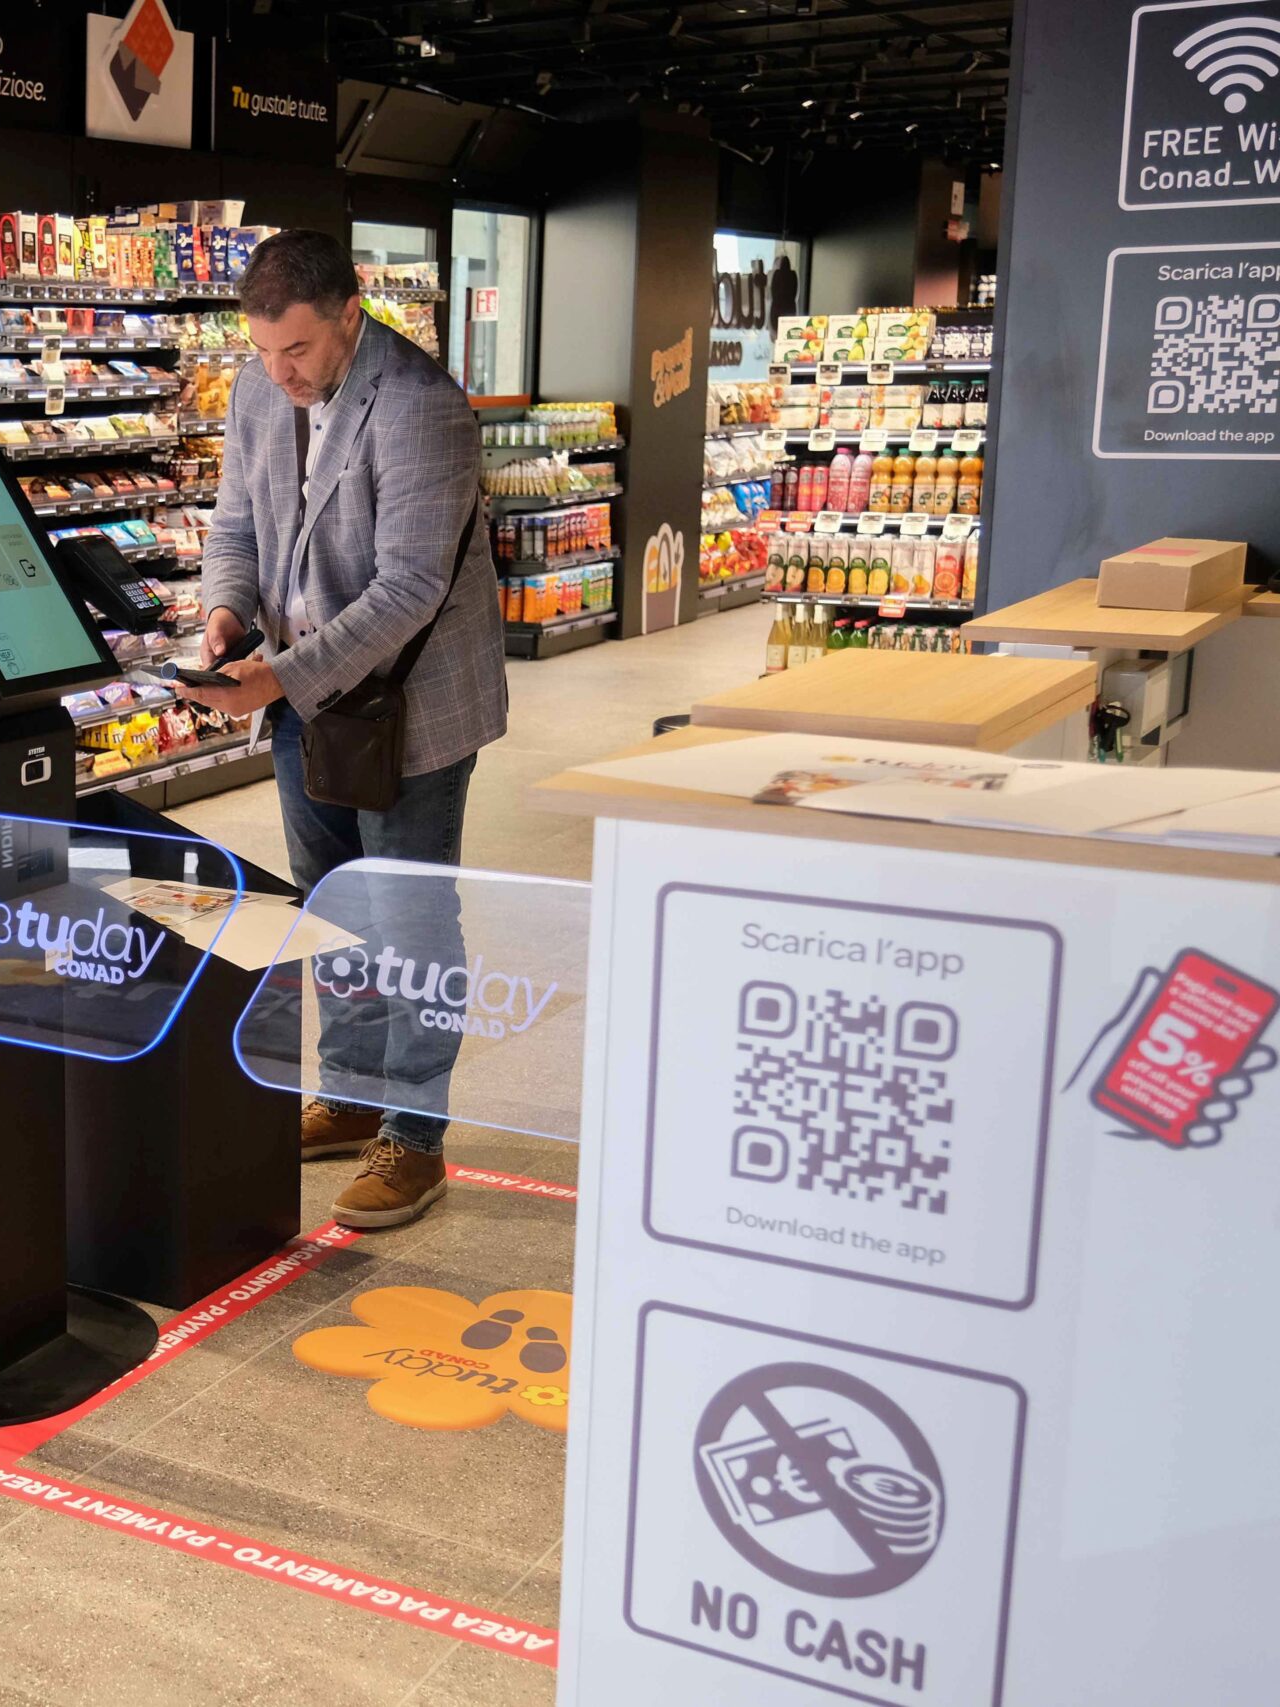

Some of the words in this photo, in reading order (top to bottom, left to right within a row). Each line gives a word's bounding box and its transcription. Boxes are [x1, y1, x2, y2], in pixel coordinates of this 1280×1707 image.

[232, 85, 249, 109] Tu
[251, 91, 295, 119] gustale
[297, 101, 328, 123] tutte.
[1143, 126, 1223, 158] FREE
[1238, 122, 1280, 153] Wi
[1139, 160, 1280, 191] Conad_W
[1157, 264, 1233, 282] Scarica
[1238, 261, 1280, 284] l'ap
[1144, 429, 1216, 442] Download
[1219, 430, 1245, 442] the
[1249, 432, 1274, 445] app
[16, 901, 166, 978] tuday
[741, 922, 867, 964] Scarica
[875, 938, 965, 981] l'app
[53, 955, 125, 984] CONAD
[374, 945, 558, 1033] tuday
[419, 1008, 505, 1040] CONAD
[1137, 1012, 1217, 1087] 5%
[454, 1168, 509, 1186] AREA
[726, 1206, 846, 1247] Download
[850, 1228, 893, 1254] the
[895, 1240, 946, 1267] app
[225, 1236, 334, 1302] PAGAMENTO
[151, 1304, 228, 1359] PAYMEN
[364, 1347, 518, 1395] tuday
[420, 1348, 490, 1369] CONAD
[61, 1495, 217, 1547] PAYMENT
[232, 1547, 445, 1622] PAGAMENTO
[452, 1612, 555, 1651] AREA
[690, 1579, 758, 1640] NO
[783, 1608, 926, 1692] CASH
